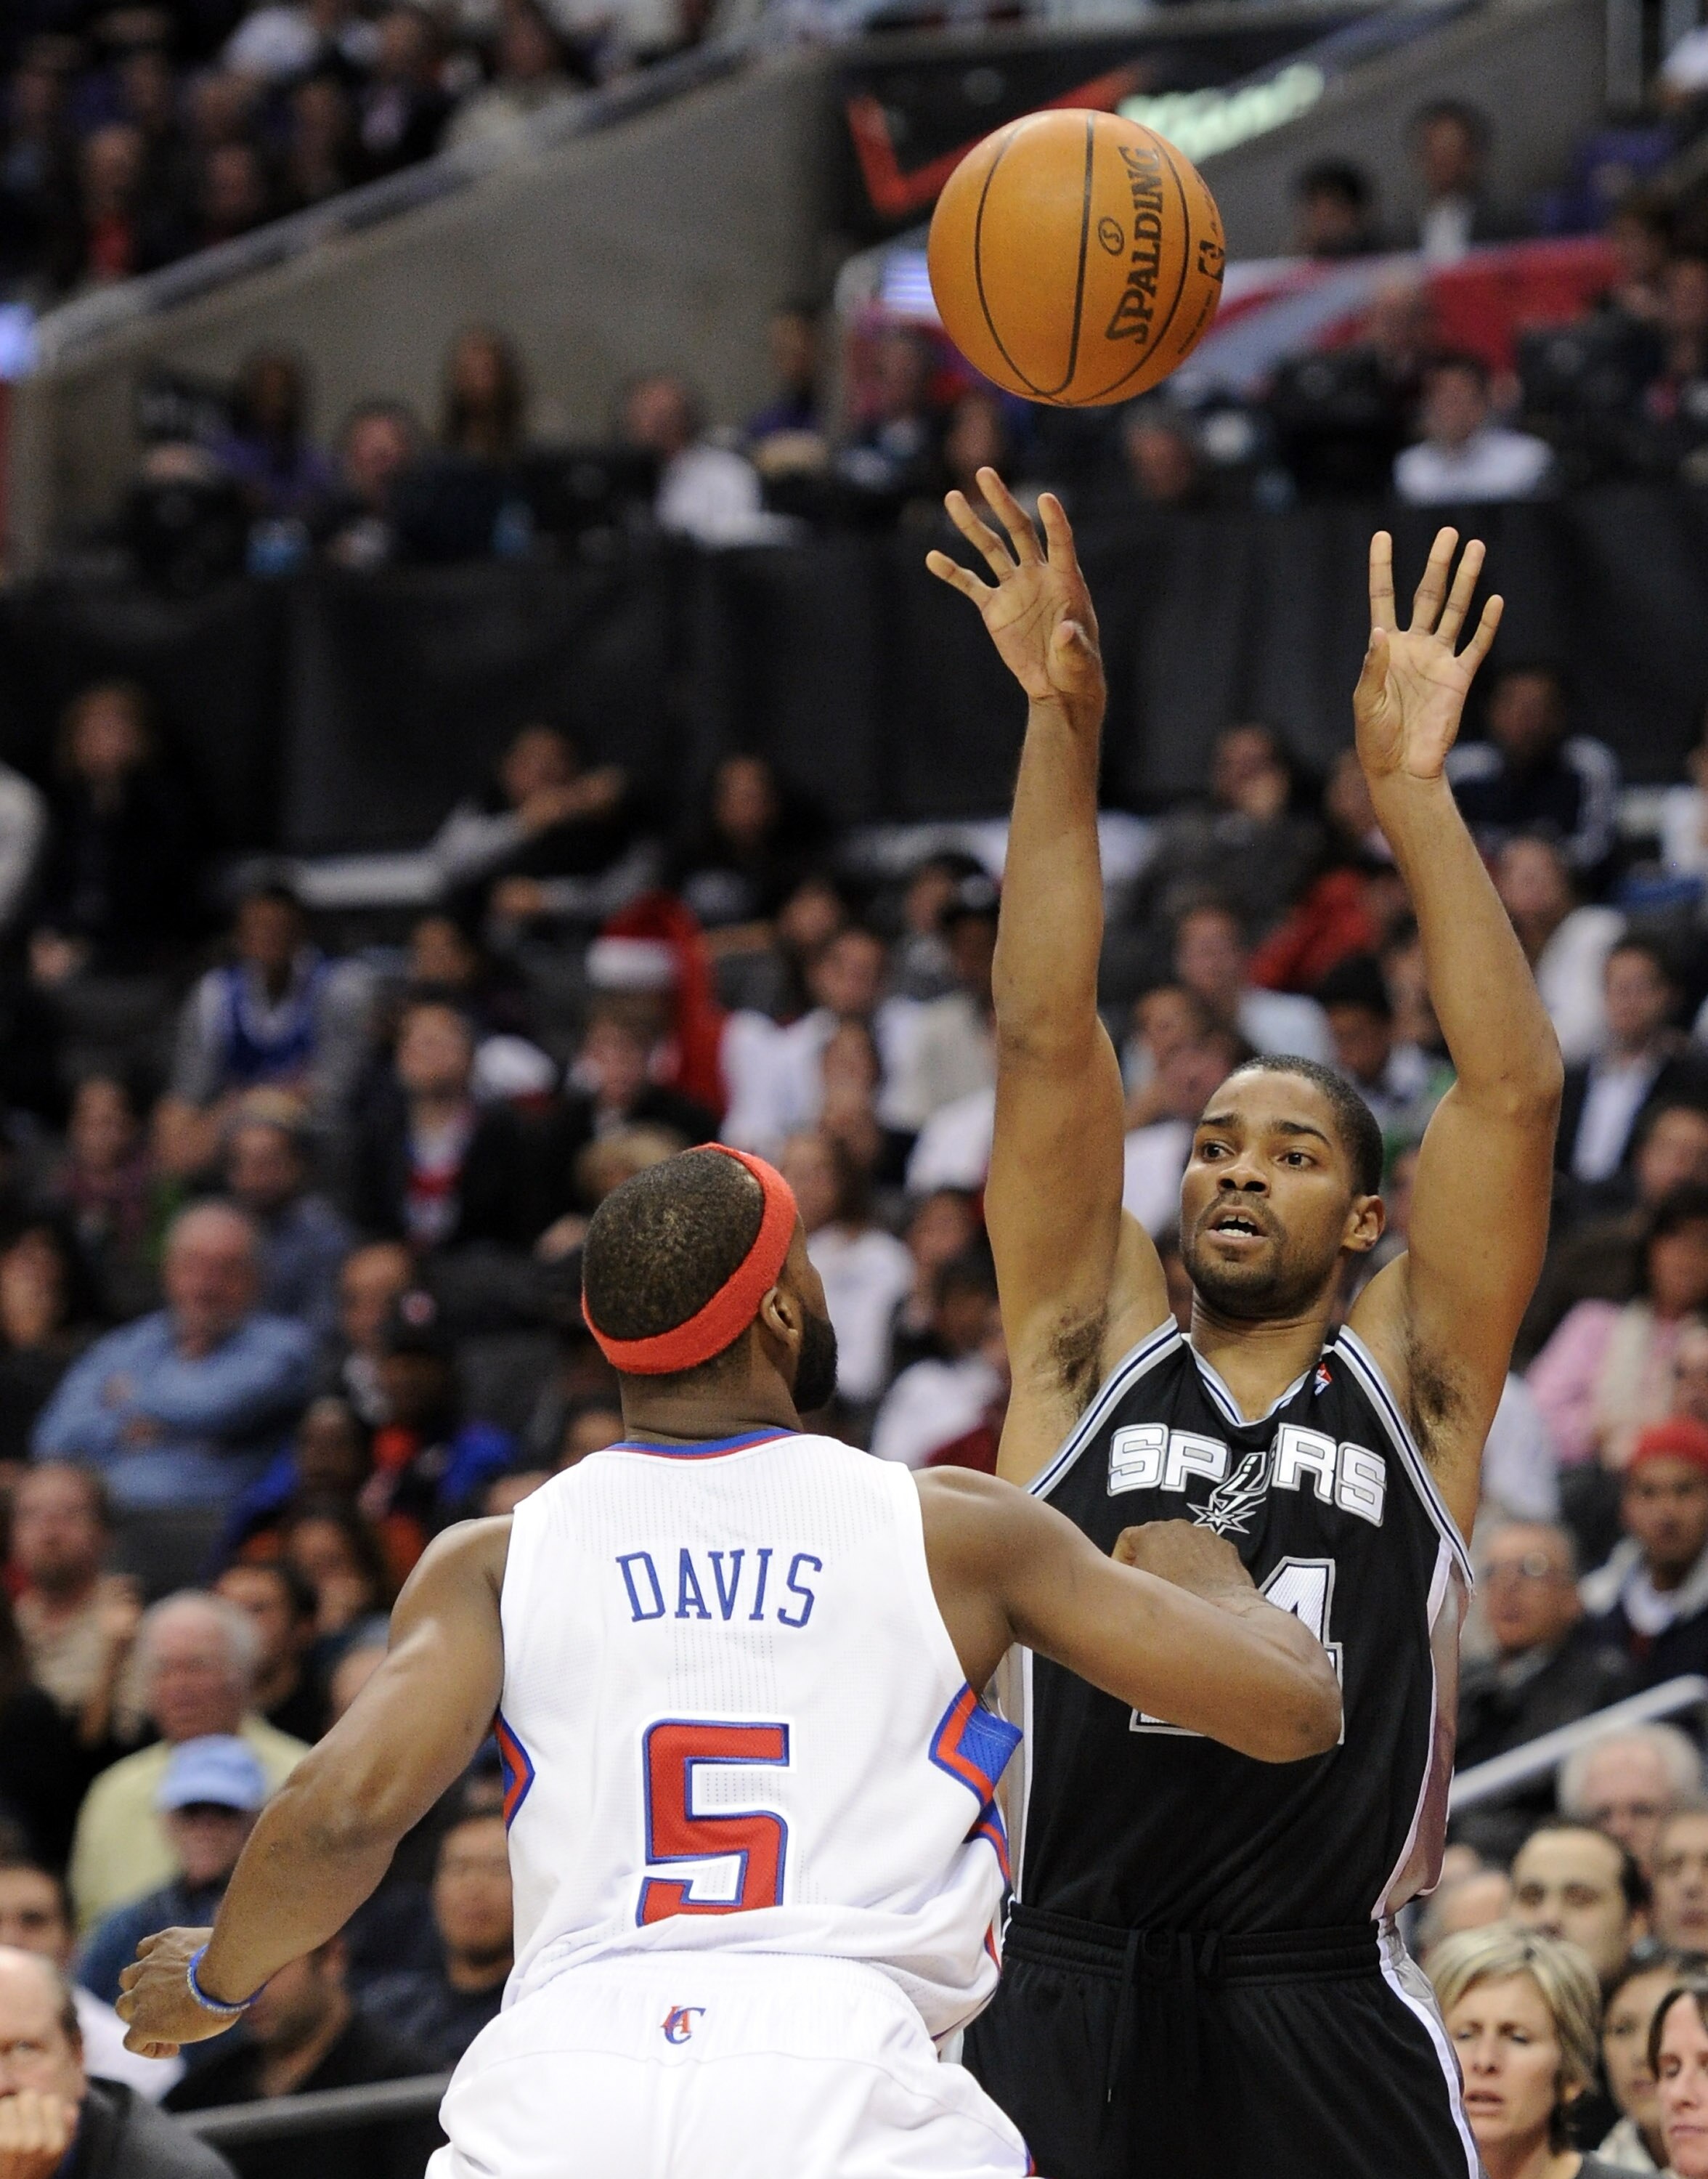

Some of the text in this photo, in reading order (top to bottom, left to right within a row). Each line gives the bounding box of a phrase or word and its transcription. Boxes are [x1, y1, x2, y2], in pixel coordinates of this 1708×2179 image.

[1105, 146, 1163, 345] SPALDING
[1107, 1422, 1387, 1535] SPURS
[615, 1548, 823, 1628] DAVIS
[635, 1717, 790, 1928] 5
